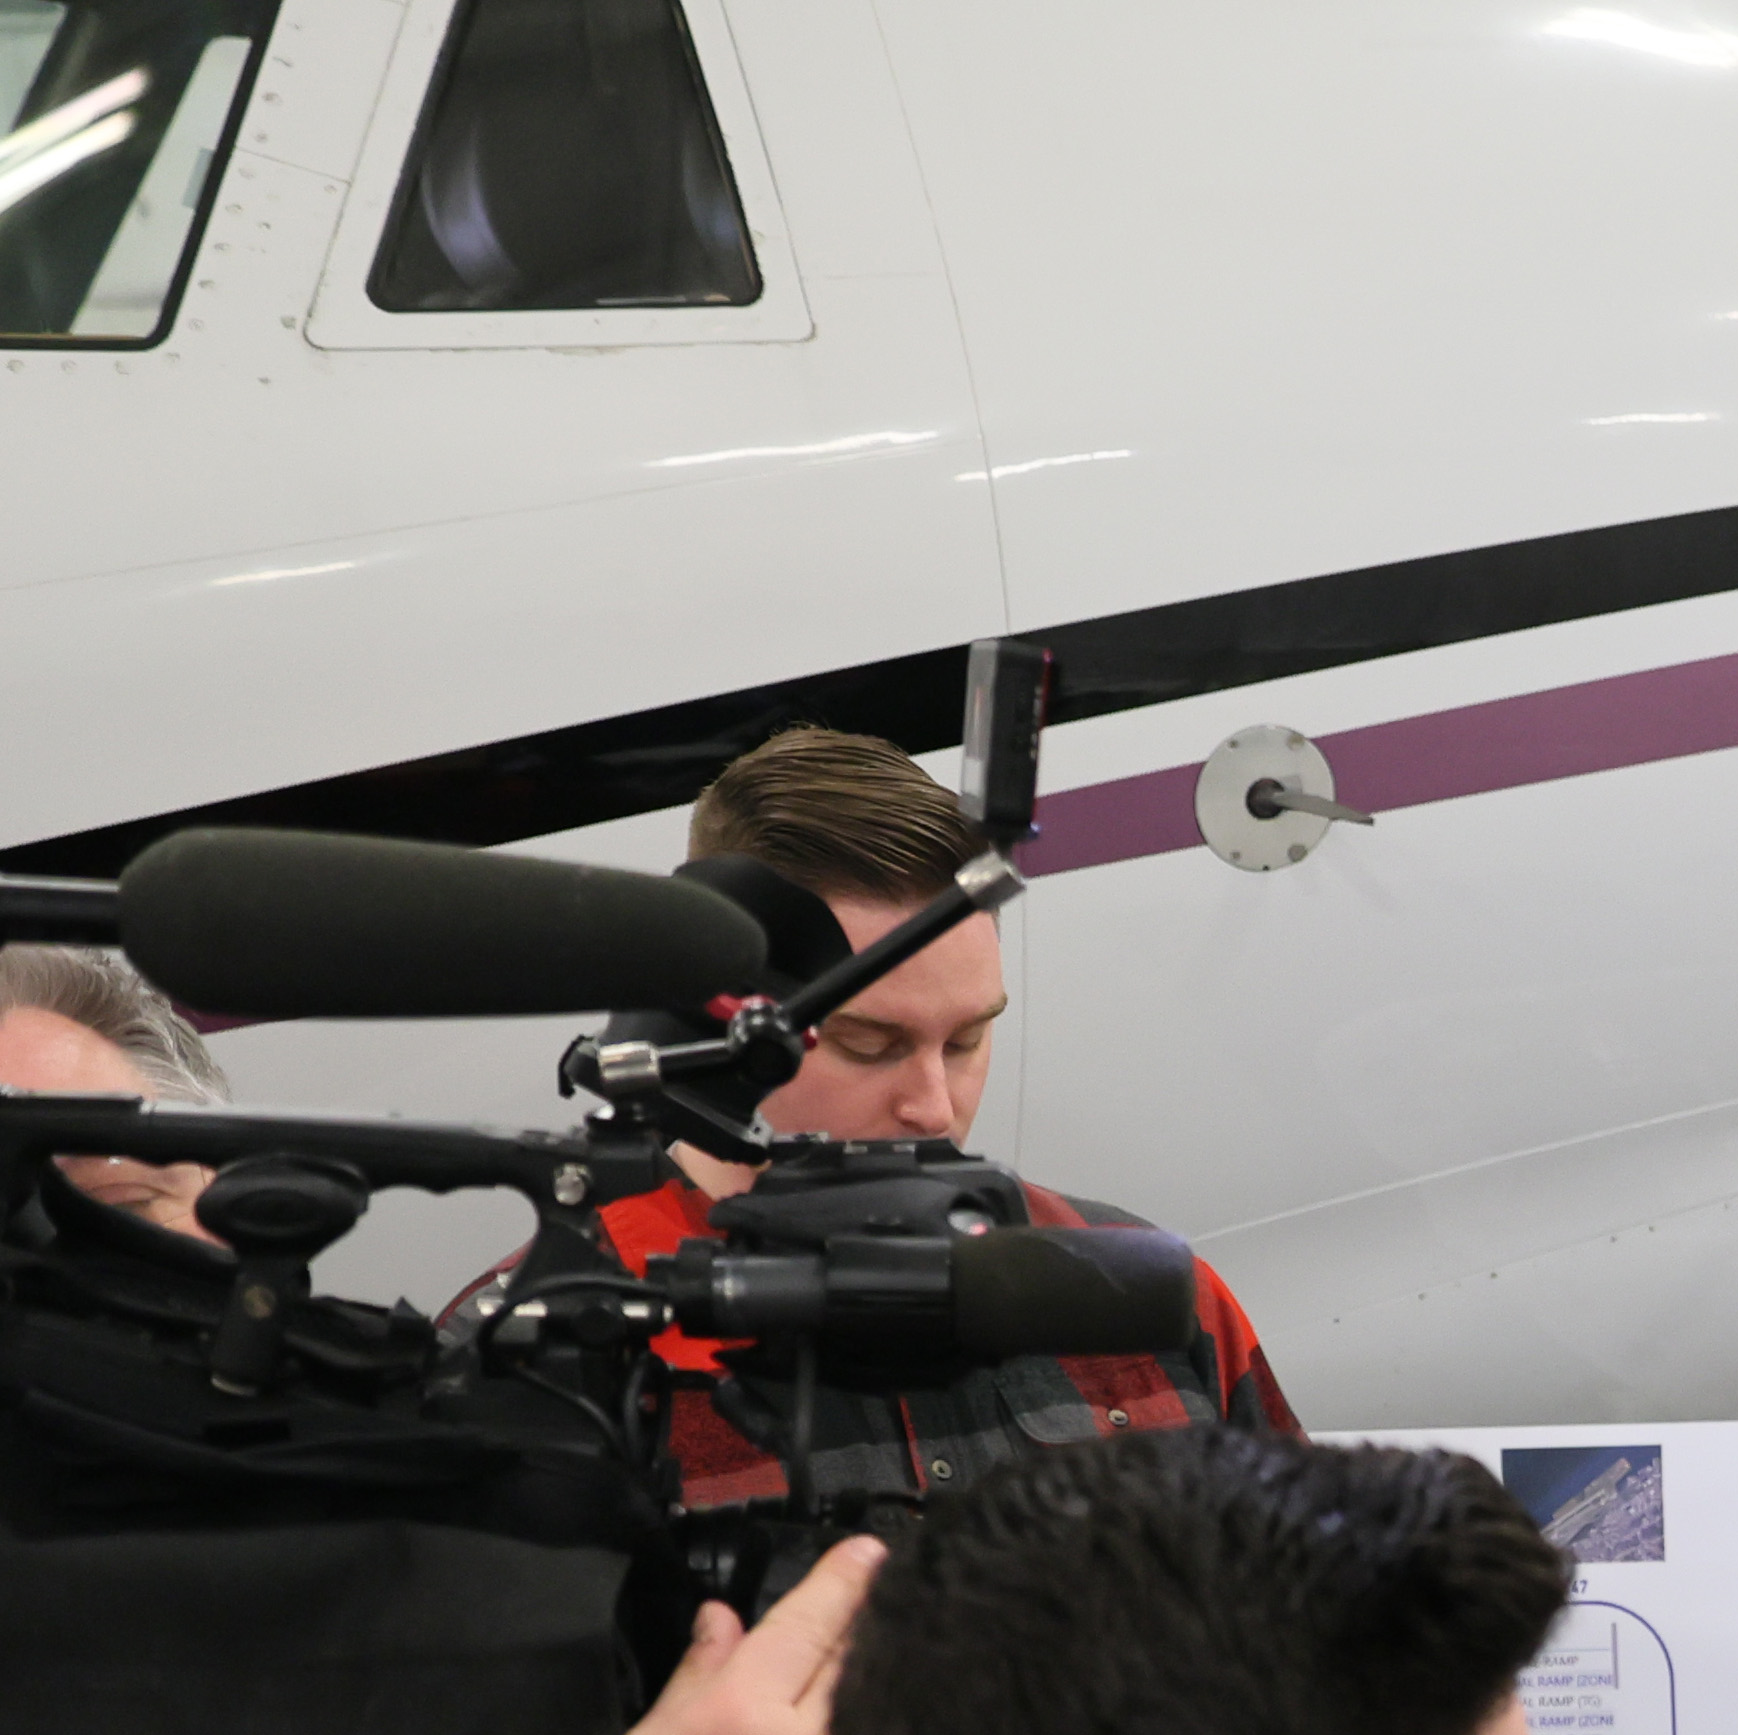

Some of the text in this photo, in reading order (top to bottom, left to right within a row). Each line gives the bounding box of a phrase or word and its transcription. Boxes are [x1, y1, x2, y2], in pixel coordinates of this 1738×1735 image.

[1537, 1675, 1573, 1687] RAMP
[1538, 1697, 1574, 1707] RAMP
[1539, 1716, 1575, 1727] RAMP
